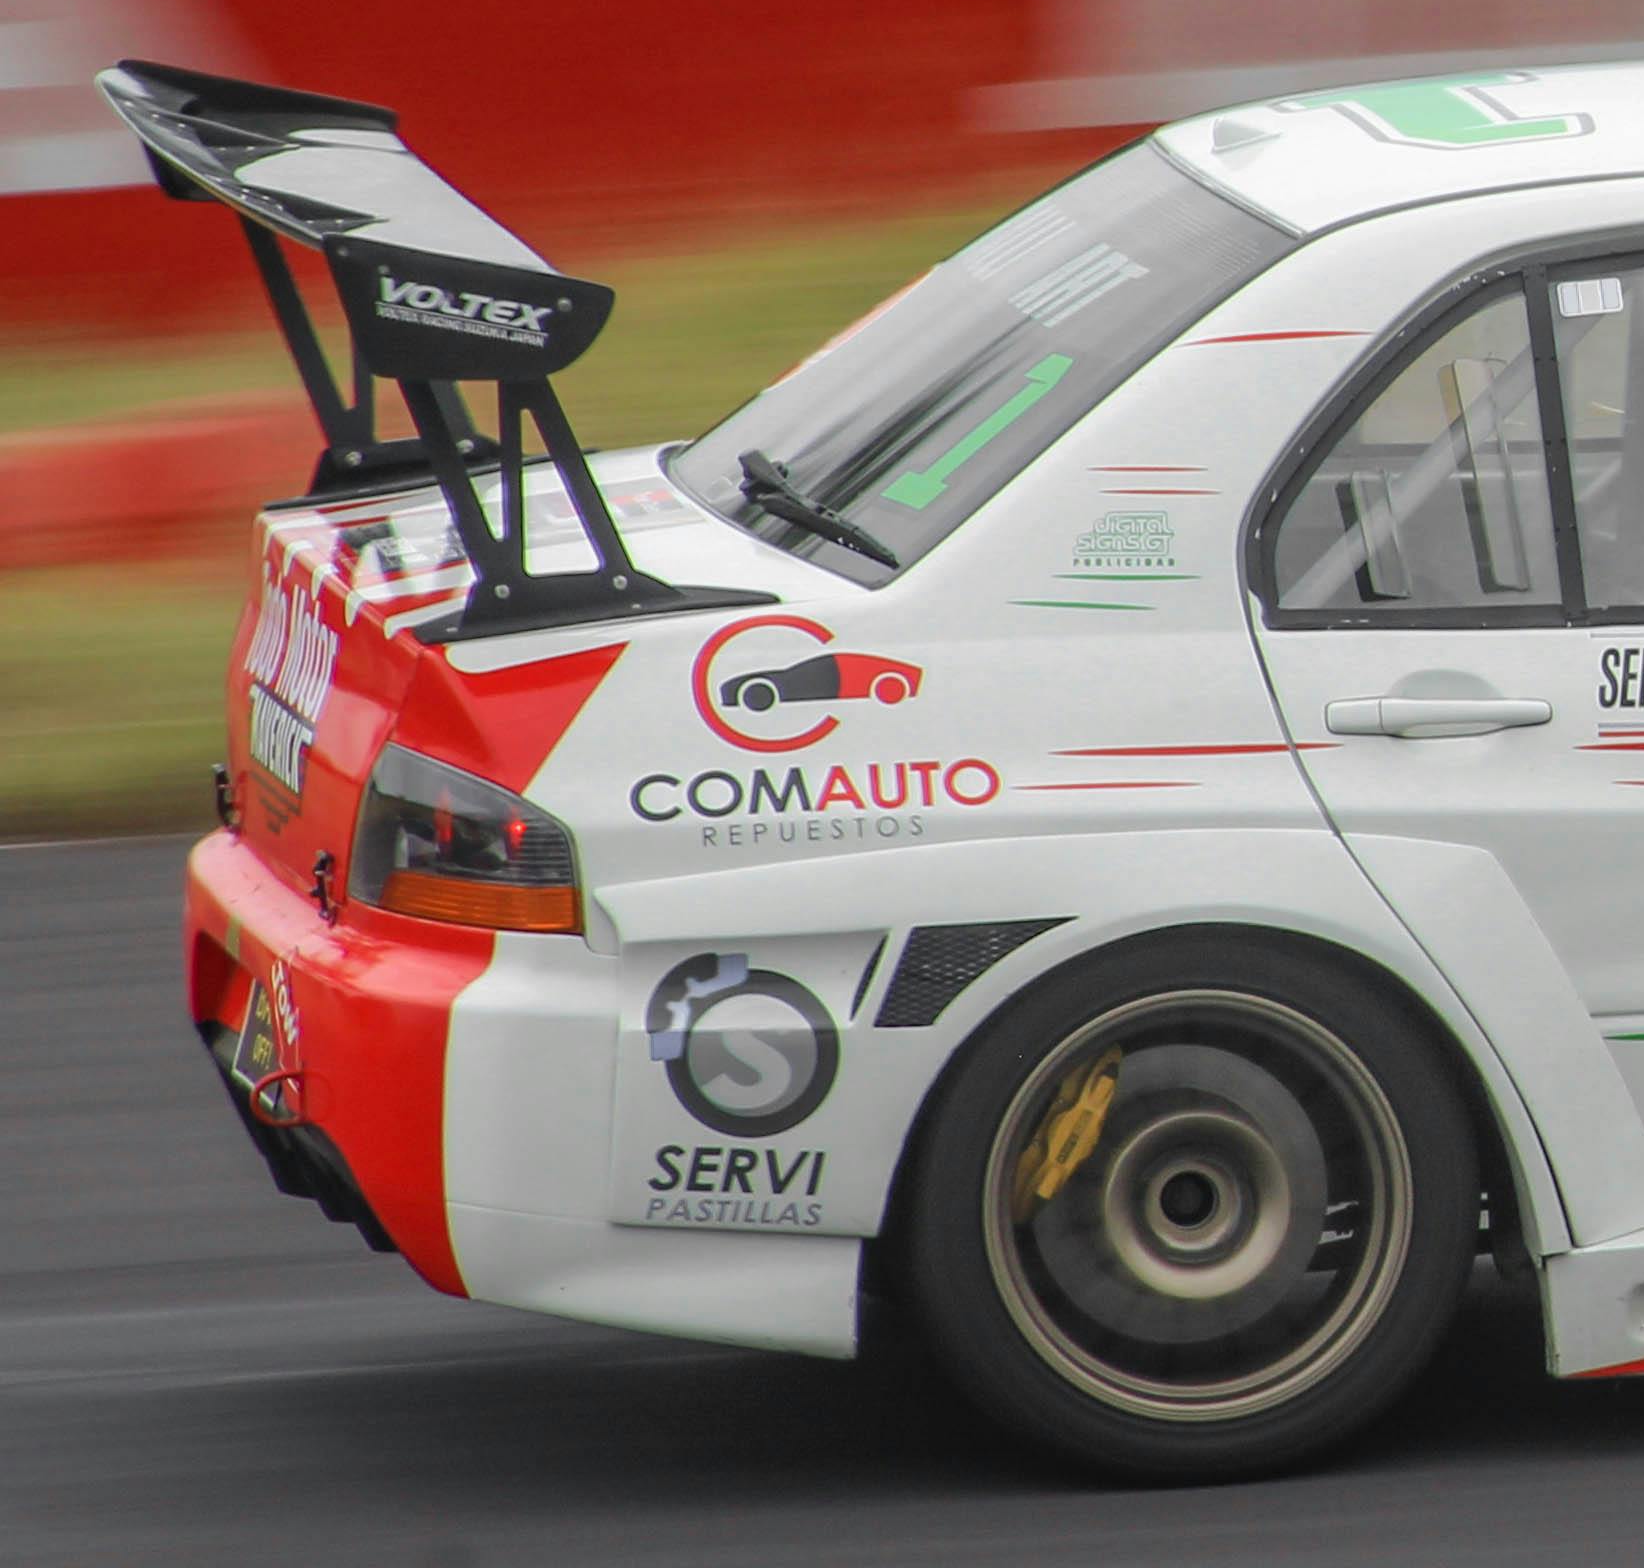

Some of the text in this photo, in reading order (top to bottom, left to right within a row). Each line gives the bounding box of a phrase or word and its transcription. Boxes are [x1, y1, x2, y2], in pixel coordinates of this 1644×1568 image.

[380, 277, 553, 331] VOLTEX
[629, 758, 1001, 822] COMAUTO
[702, 815, 925, 848] REPUESTOS
[648, 1144, 827, 1197] SERVI
[645, 1197, 824, 1226] PASTILLAS
